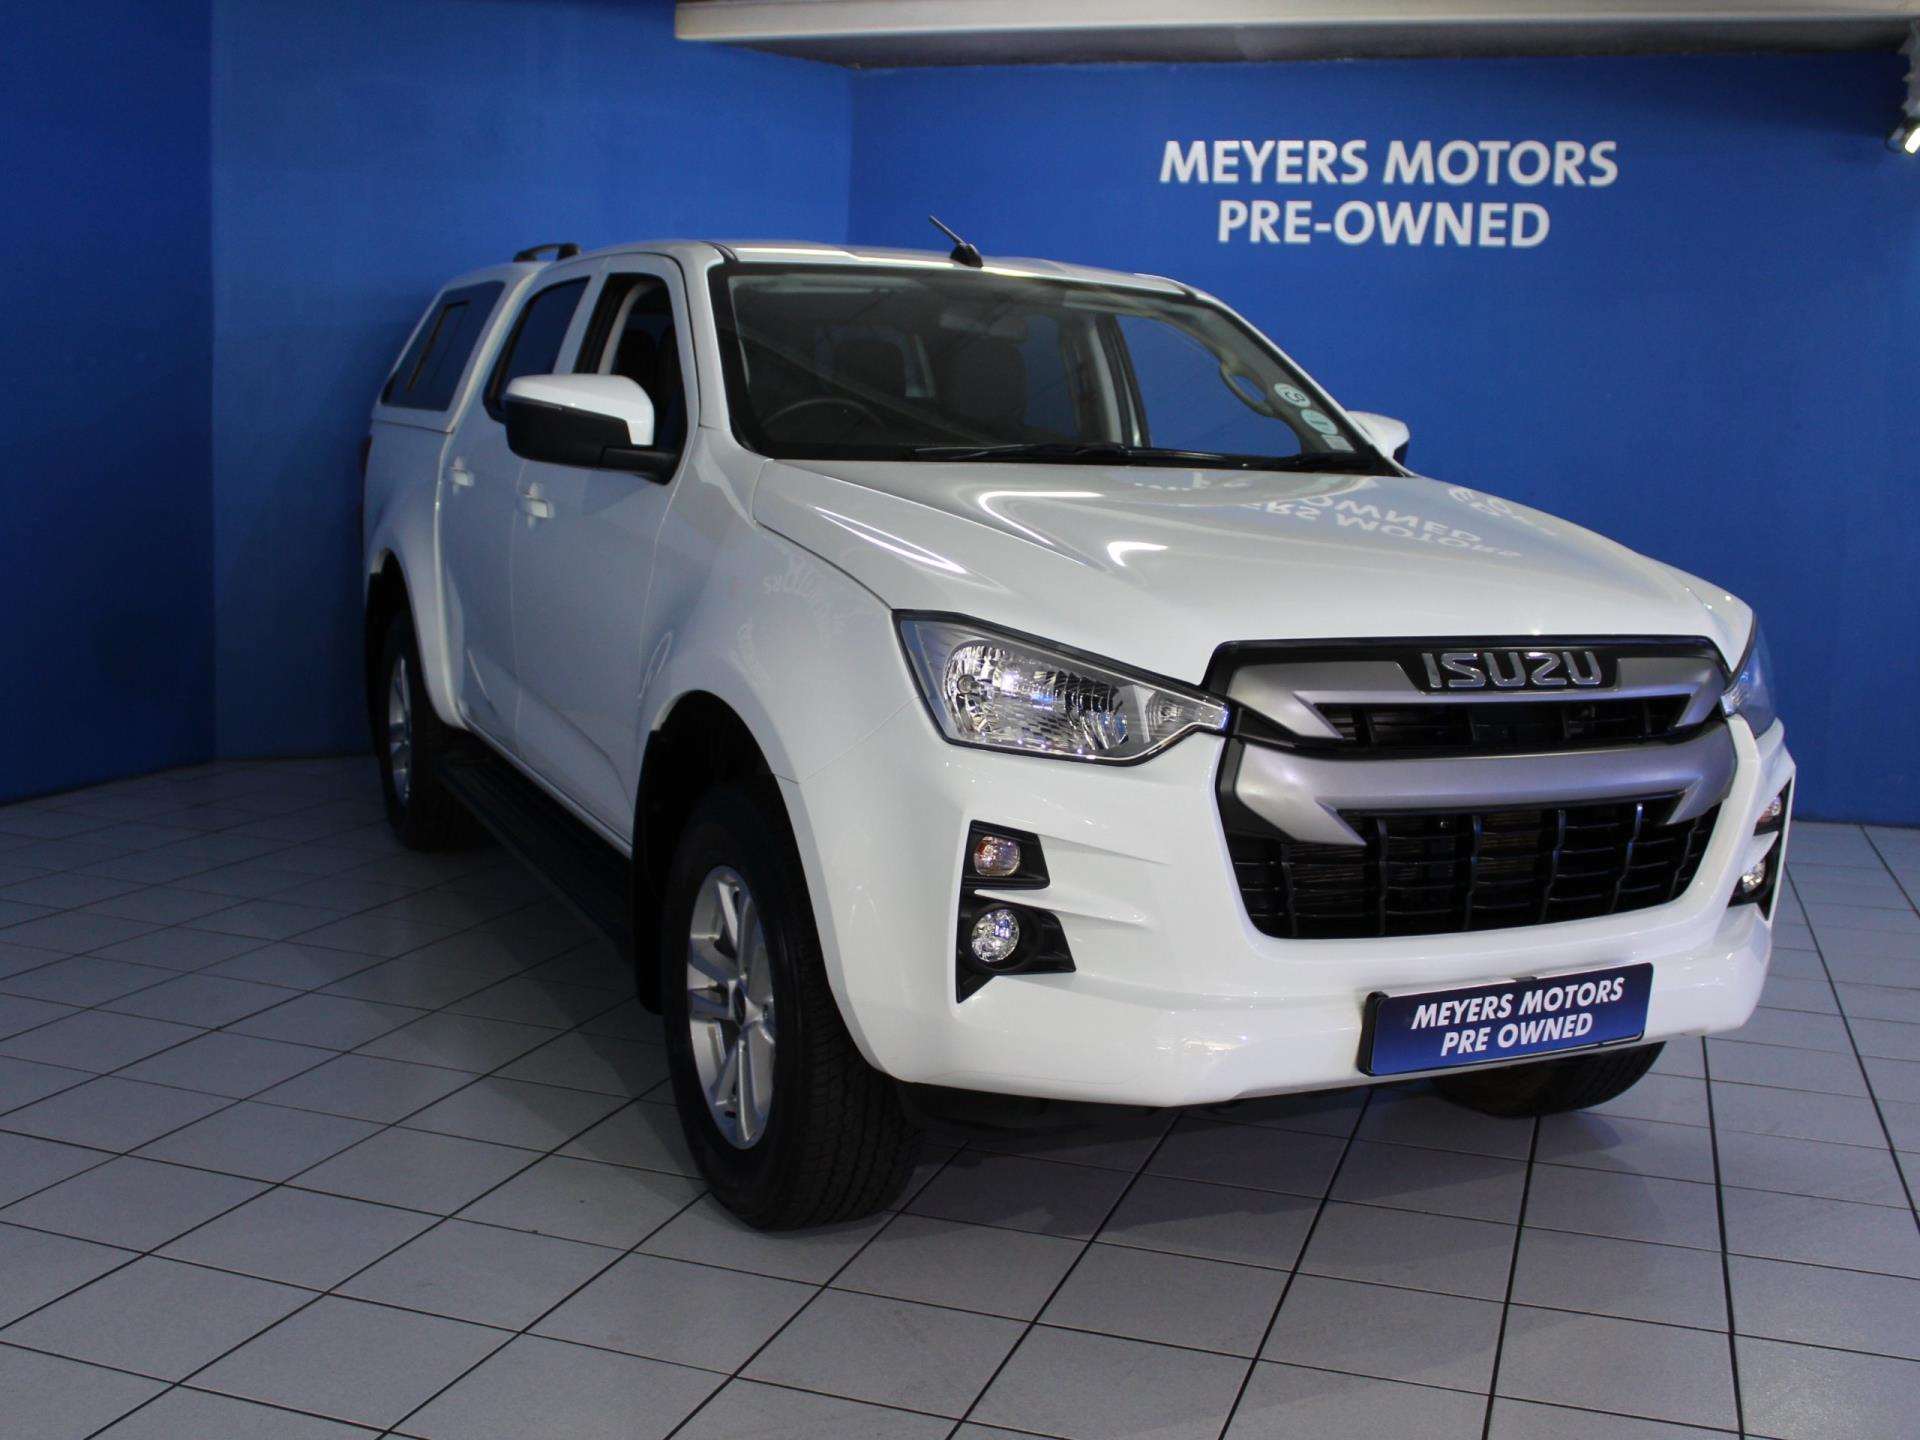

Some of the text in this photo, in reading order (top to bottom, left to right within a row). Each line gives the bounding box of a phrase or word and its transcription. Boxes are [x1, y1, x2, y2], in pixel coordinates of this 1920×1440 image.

[1159, 139, 1618, 186] MEYERS MOTORS
[1218, 199, 1550, 247] PRE-OWNED
[1421, 651, 1601, 688] ISUZU
[1411, 977, 1624, 1029] MEYERS MOTORS
[1440, 1013, 1593, 1056] PRE OWNED
